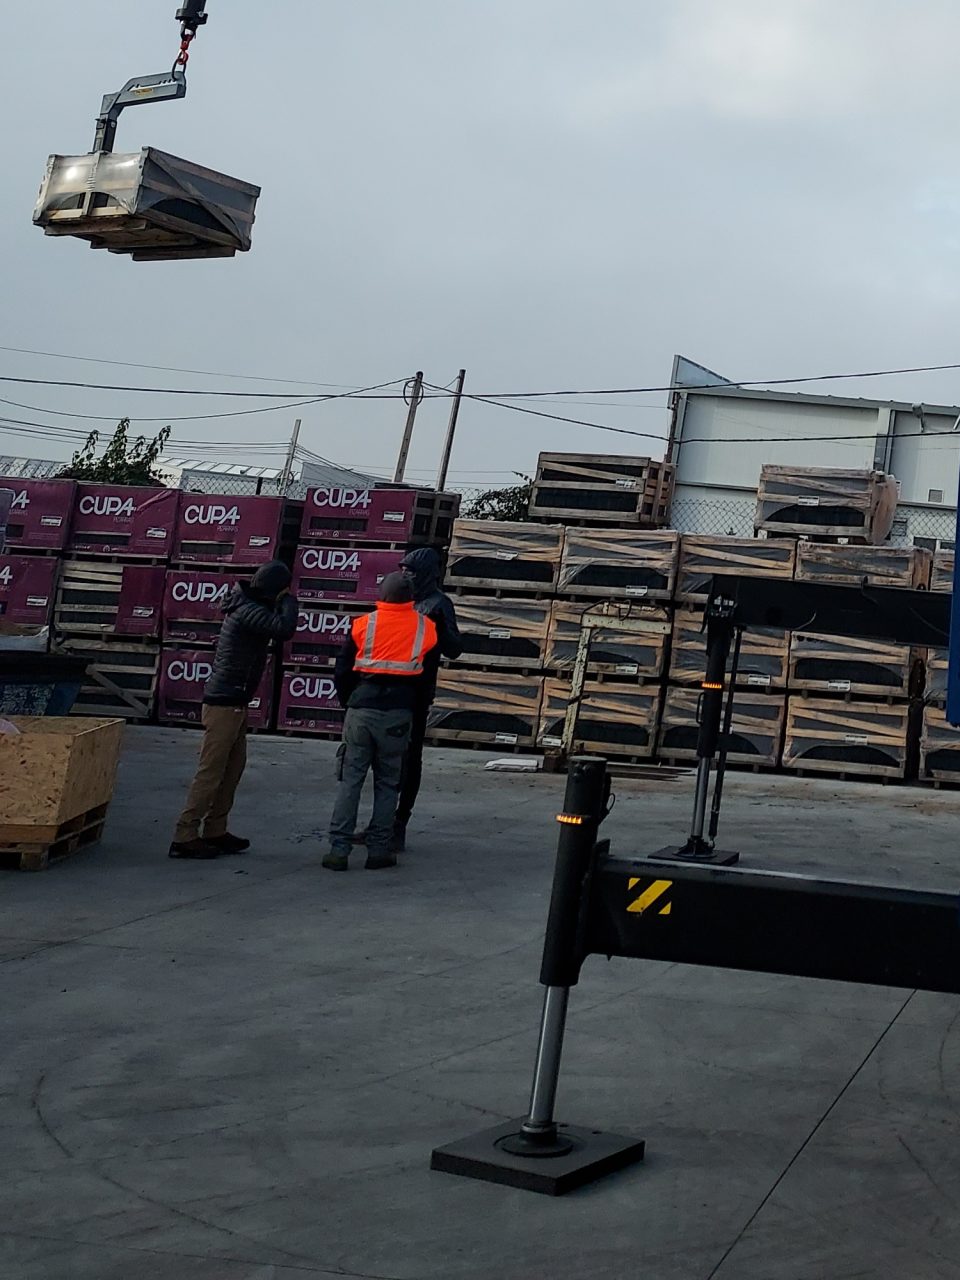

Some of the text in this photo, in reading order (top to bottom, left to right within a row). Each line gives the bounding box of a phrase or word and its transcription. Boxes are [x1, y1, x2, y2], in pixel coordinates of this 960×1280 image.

[79, 495, 136, 517] CUPA
[313, 487, 372, 509] CUPA
[184, 505, 241, 525] CUPA
[302, 549, 362, 571] CUPA
[167, 661, 213, 682] CUP
